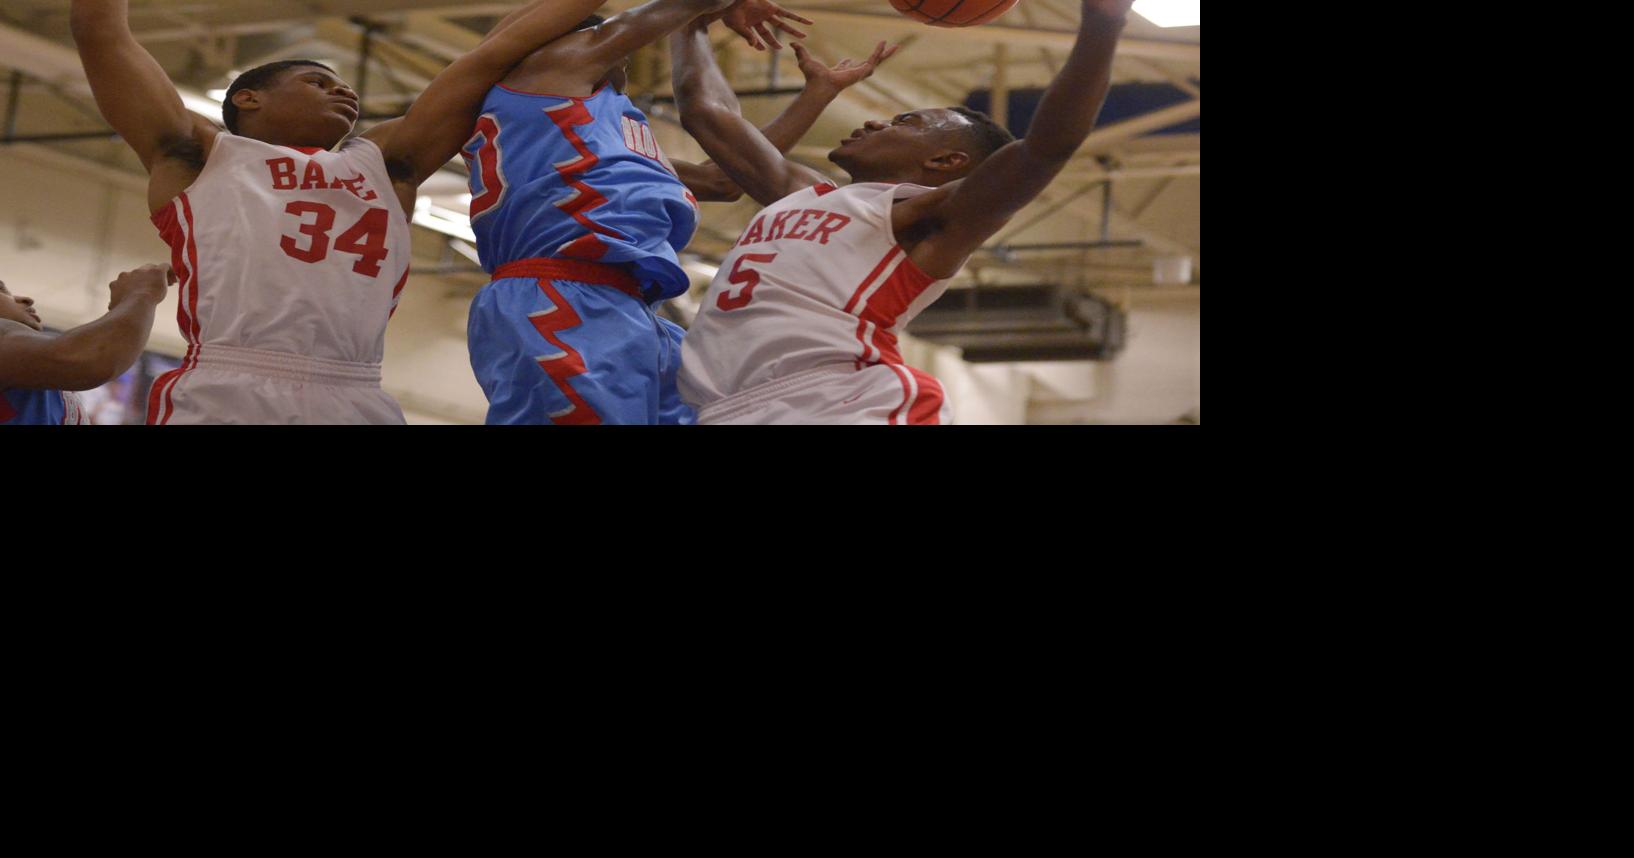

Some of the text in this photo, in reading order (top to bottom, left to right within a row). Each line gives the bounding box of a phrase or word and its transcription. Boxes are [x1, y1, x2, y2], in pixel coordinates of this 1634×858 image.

[280, 201, 389, 278] 34
[731, 208, 851, 249] AKER
[716, 252, 778, 312] 5
